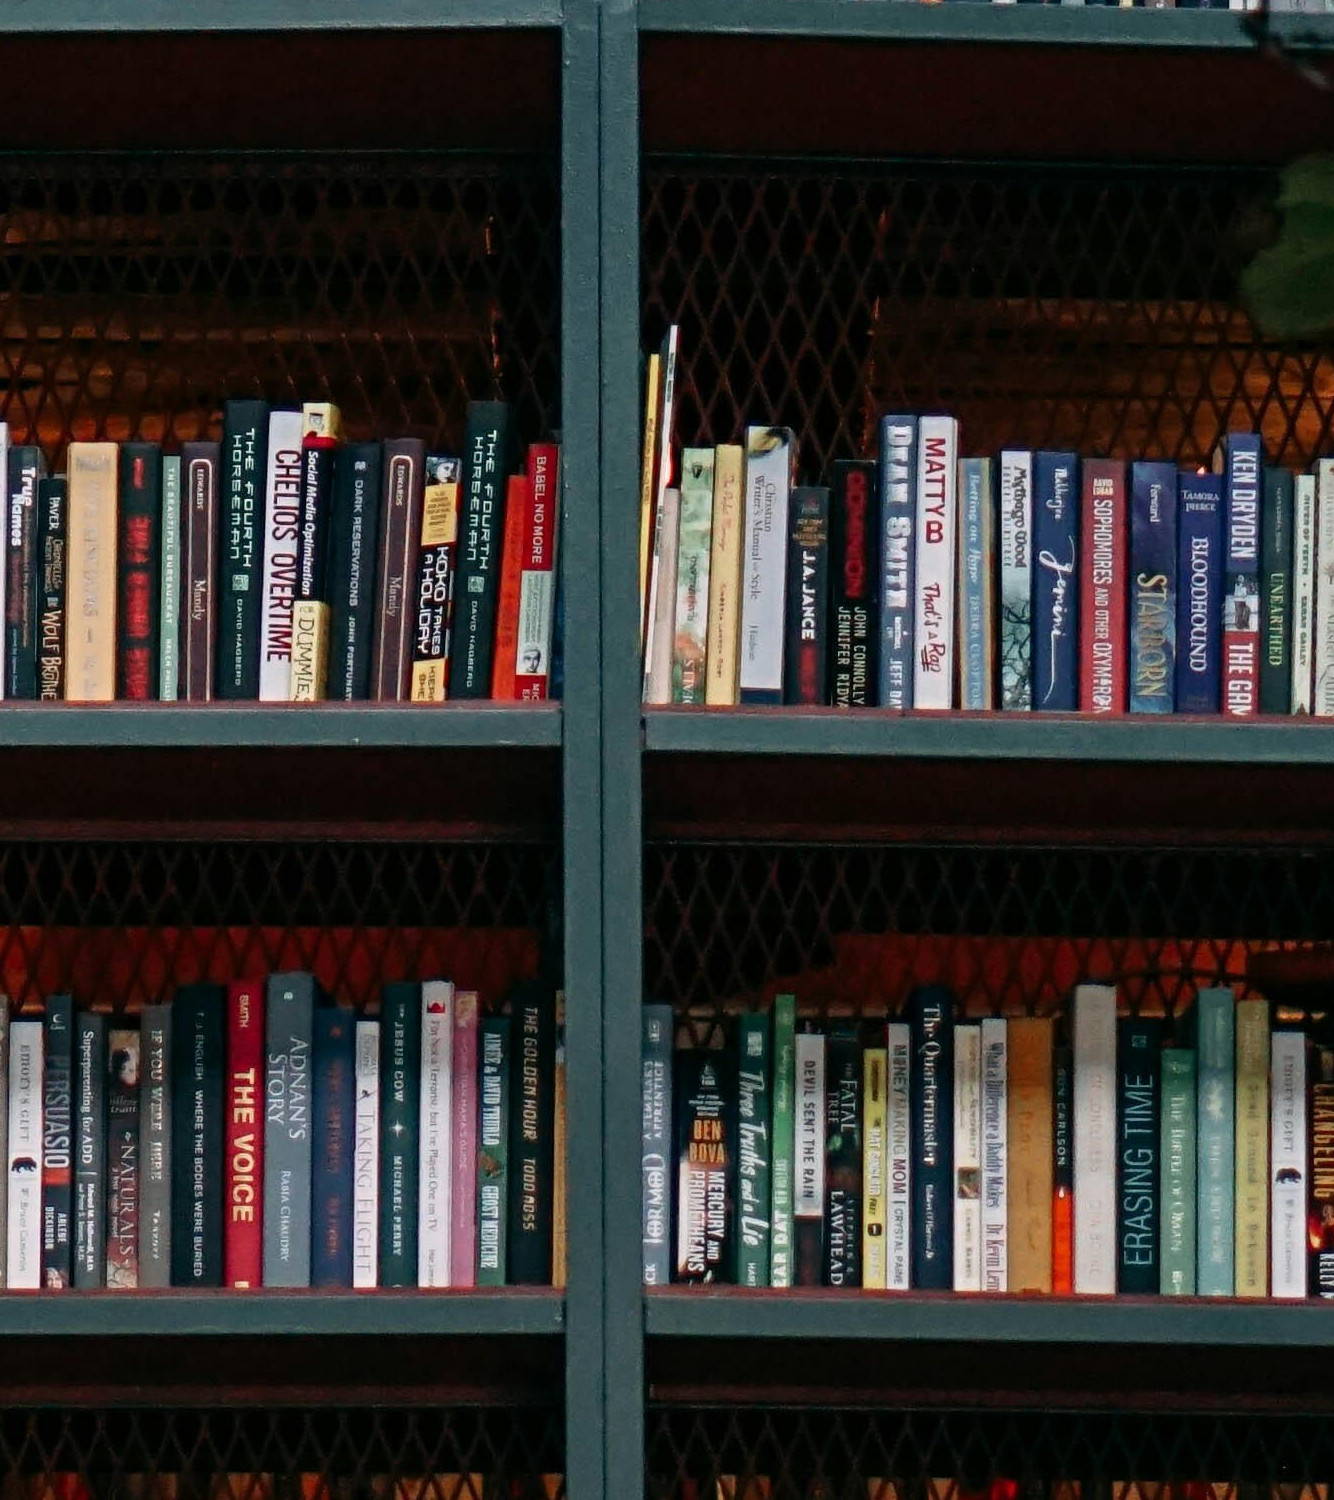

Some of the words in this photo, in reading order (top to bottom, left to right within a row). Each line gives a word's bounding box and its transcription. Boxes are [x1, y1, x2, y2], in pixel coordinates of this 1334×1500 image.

[22, 467, 36, 506] True
[274, 450, 300, 541] CHELIOS
[535, 456, 546, 500] BABEL
[925, 438, 945, 515] MATTY
[1233, 451, 1256, 483] KEN
[10, 493, 25, 546] Names
[531, 526, 544, 564] MORE
[534, 504, 545, 523] NO
[1231, 490, 1256, 558] DRYDEN
[268, 554, 294, 662] OVERTIME
[1190, 537, 1208, 671] BLOODHOUND
[1268, 573, 1283, 665] UNEARTHED
[79, 1031, 95, 1113] Superparenting
[234, 1068, 255, 1123] THE
[81, 1116, 94, 1133] for
[1125, 1074, 1153, 1138] TIME
[81, 1135, 94, 1163] ADD
[233, 1134, 254, 1221] VOICE
[688, 1171, 706, 1271] PROMETHEANS
[707, 1171, 725, 1237] MERCURY
[830, 1190, 845, 1284] LAWHEAD
[1124, 1149, 1153, 1265] ERASING
[708, 1241, 720, 1259] AND
